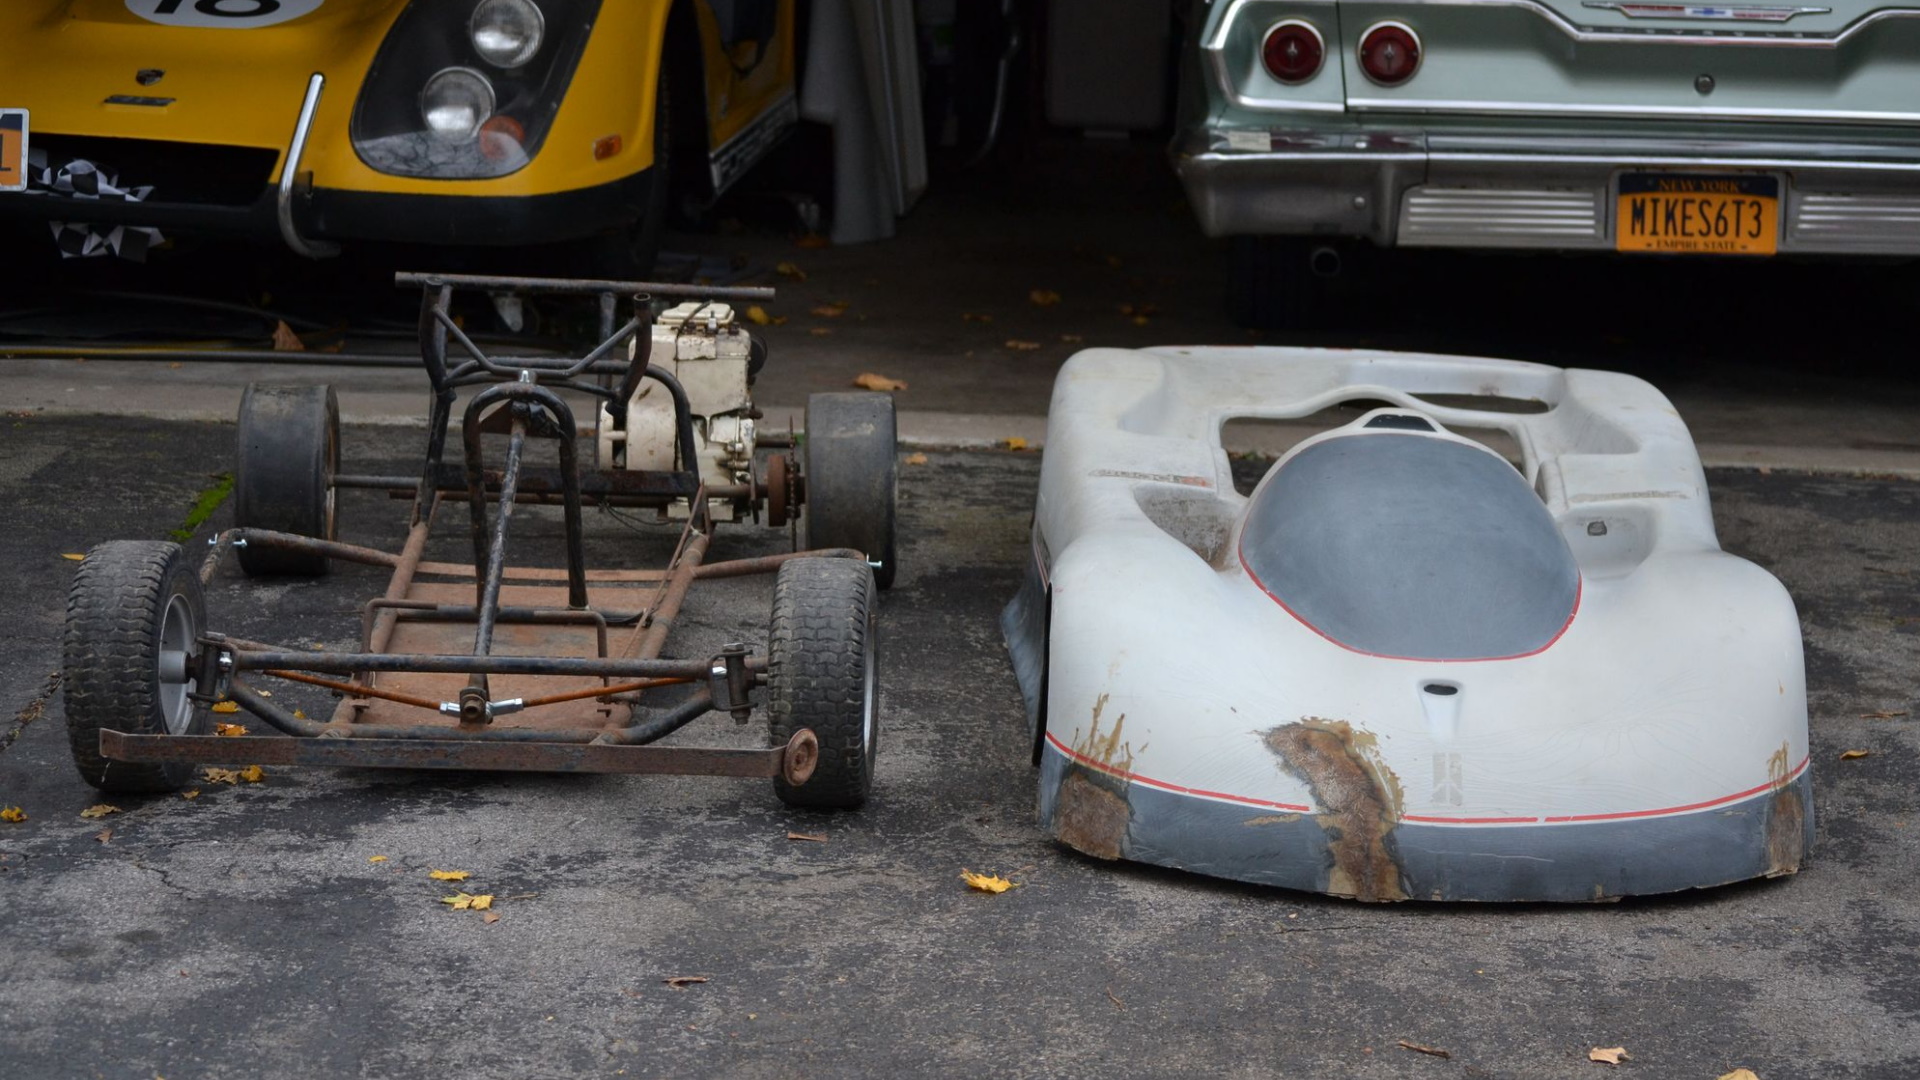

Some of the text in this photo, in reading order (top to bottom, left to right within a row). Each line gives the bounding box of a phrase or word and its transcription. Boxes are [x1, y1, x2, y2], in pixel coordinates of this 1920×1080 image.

[1659, 179, 1739, 192] NEW YORK
[1631, 198, 1762, 238] MIKES6T3
[1656, 239, 1735, 250] EMPIRE STATE
